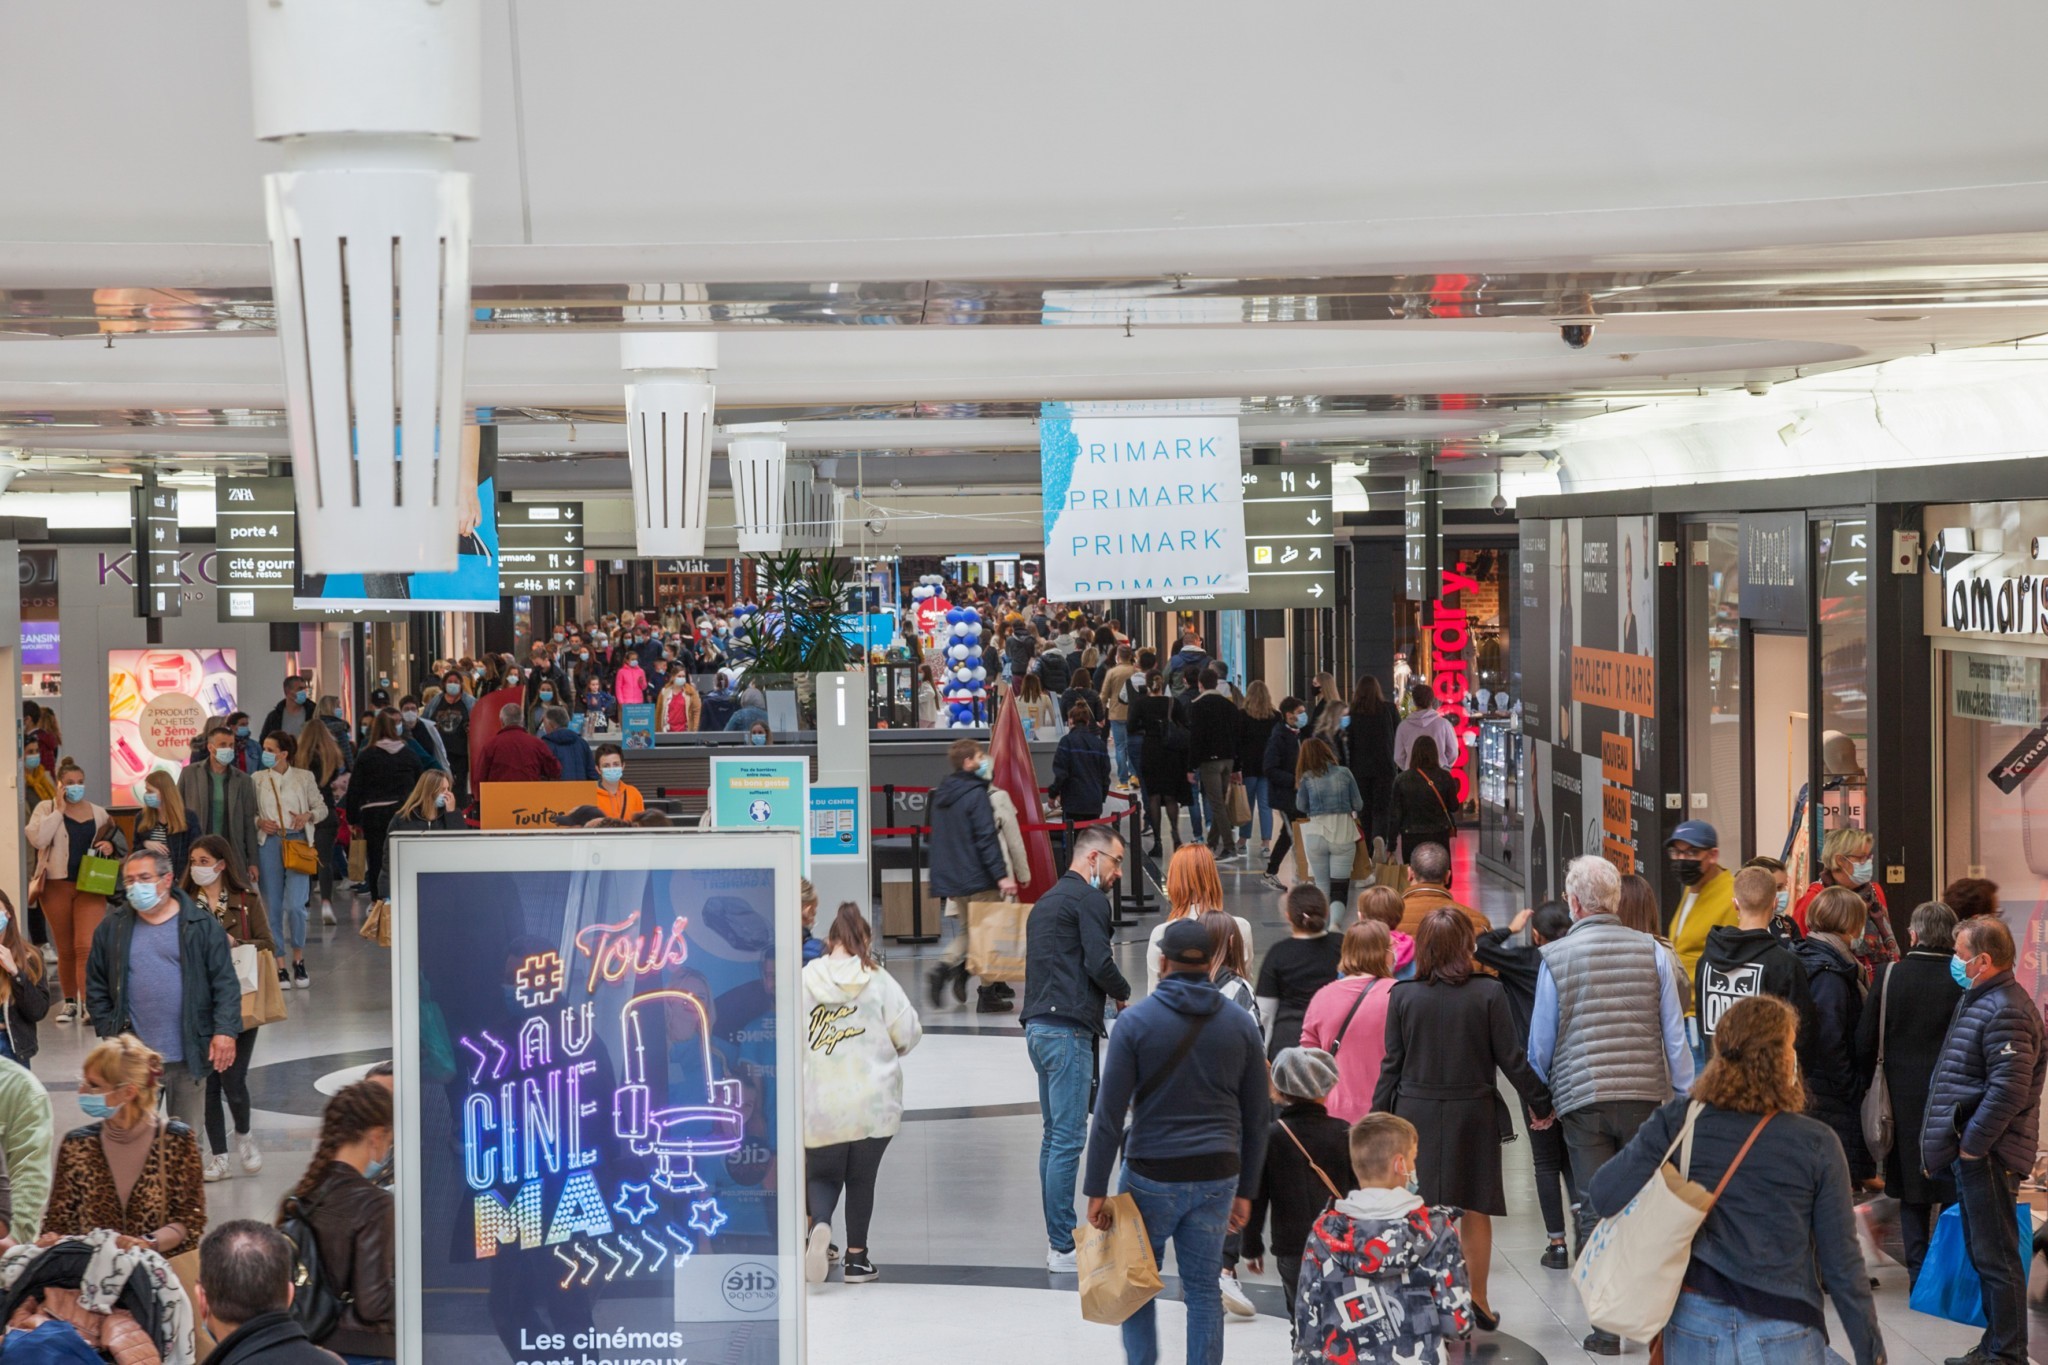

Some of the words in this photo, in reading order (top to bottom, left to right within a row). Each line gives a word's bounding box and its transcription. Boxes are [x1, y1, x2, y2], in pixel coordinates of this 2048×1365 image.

[228, 488, 255, 501] ZARA
[1070, 483, 1219, 510] PRIMARK
[230, 527, 267, 540] porte
[269, 525, 278, 537] 4
[1072, 528, 1222, 556] PRIMARK
[498, 553, 536, 562] urmande
[1583, 542, 1608, 564] OUVERTURE
[1748, 524, 1794, 586] KAPORAL
[229, 558, 254, 570] cité
[257, 560, 294, 574] gourm
[229, 570, 254, 579] cinés,
[256, 570, 282, 579] restos
[1583, 572, 1608, 594] PROCHAINE
[1574, 657, 1612, 697] PROJECT
[1615, 664, 1621, 699] X
[1625, 665, 1652, 706] PARIS
[148, 709, 154, 717] 2
[154, 708, 199, 716] PRODUITS
[153, 716, 194, 726] ACHETÉS
[151, 726, 161, 736] le
[164, 726, 197, 736] 3ème
[1602, 740, 1628, 771] NOUVEAU
[764, 780, 789, 788] gestes
[1603, 793, 1627, 825] MAGASIN
[575, 910, 689, 993] Tous
[519, 1000, 596, 1071] AU
[474, 1168, 616, 1260] MA
[520, 1328, 566, 1350] Les
[572, 1326, 684, 1350] cinémas
